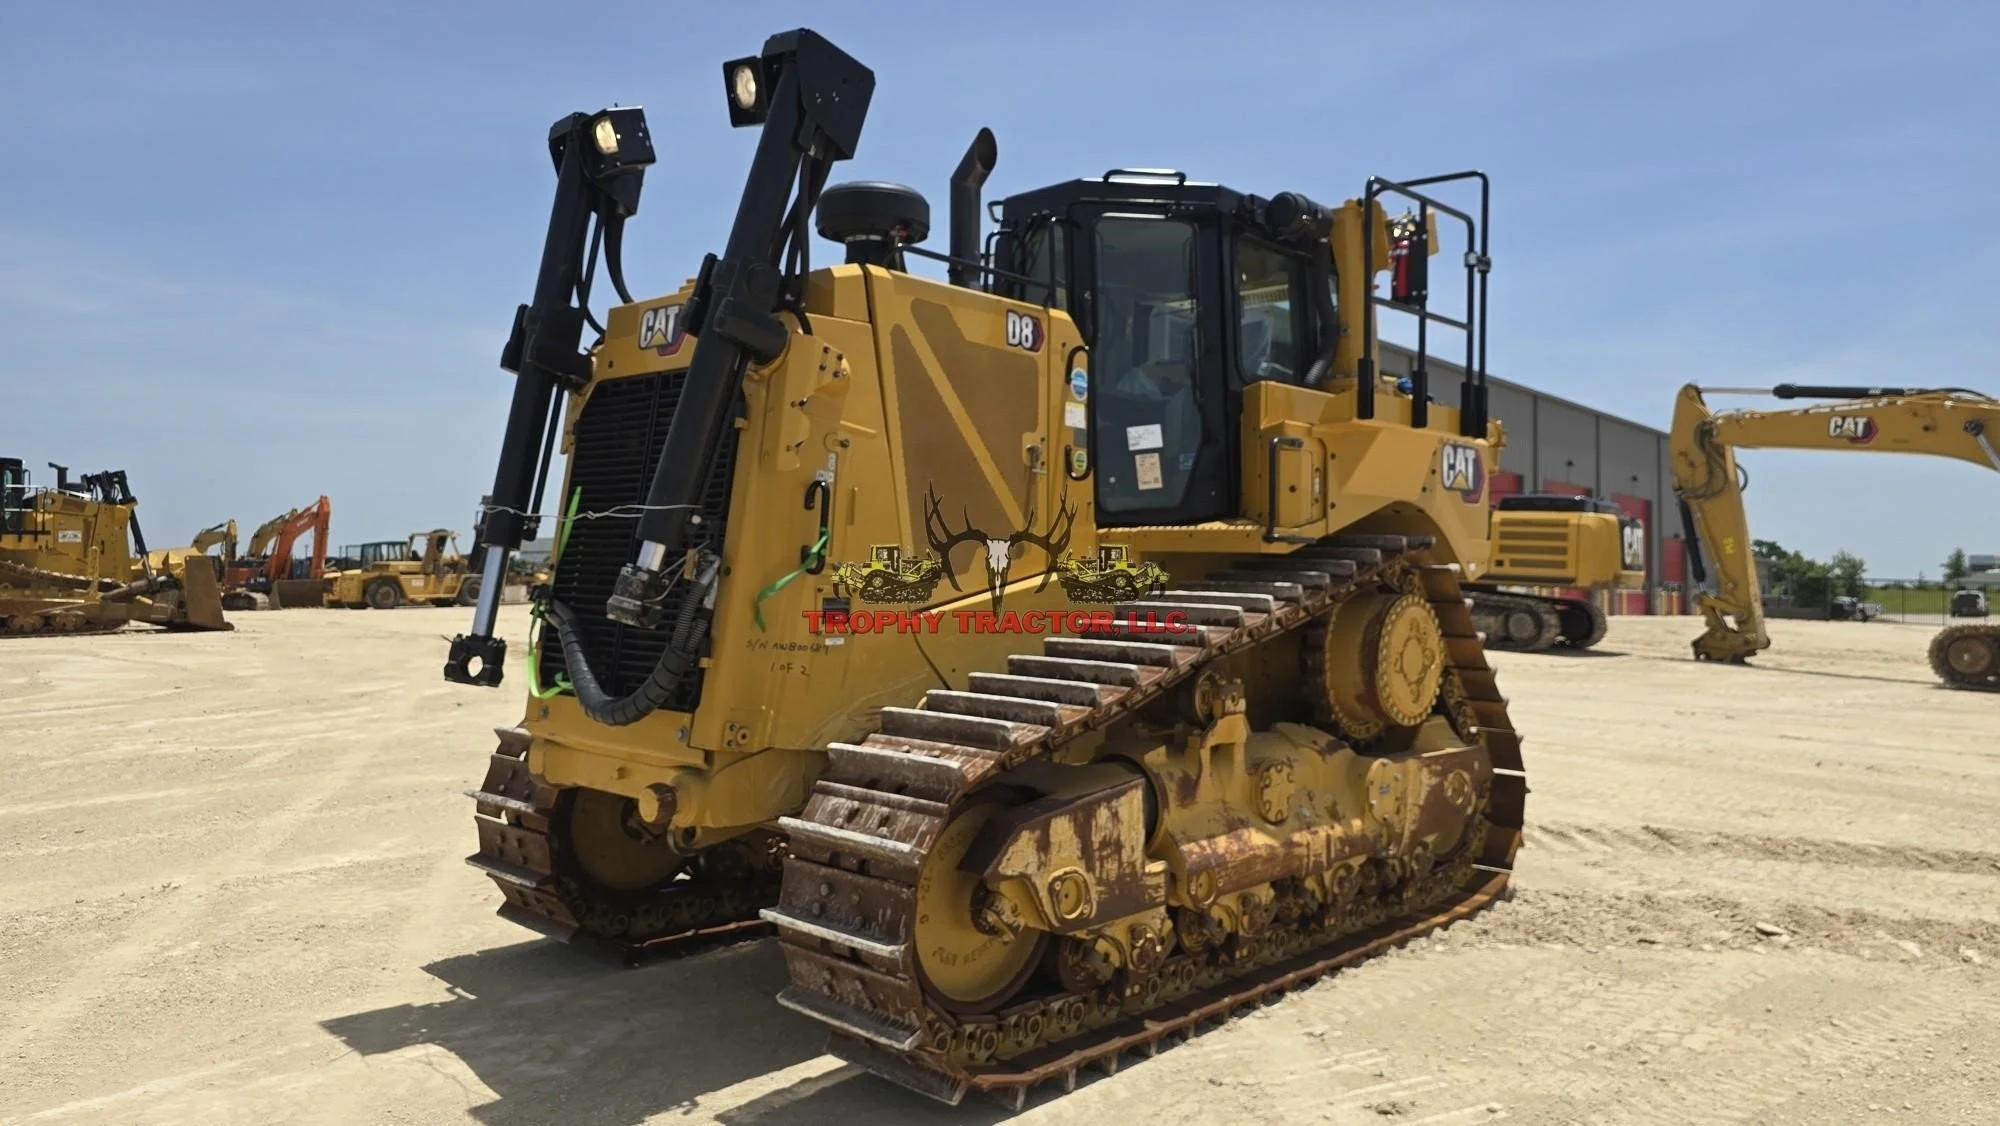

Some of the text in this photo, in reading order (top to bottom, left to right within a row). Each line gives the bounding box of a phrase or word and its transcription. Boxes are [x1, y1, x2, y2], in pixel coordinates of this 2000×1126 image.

[639, 305, 680, 348] CAT
[1007, 311, 1033, 349] D8
[1828, 416, 1868, 438] CAT
[1443, 444, 1476, 490] CAT
[800, 664, 811, 678] 2
